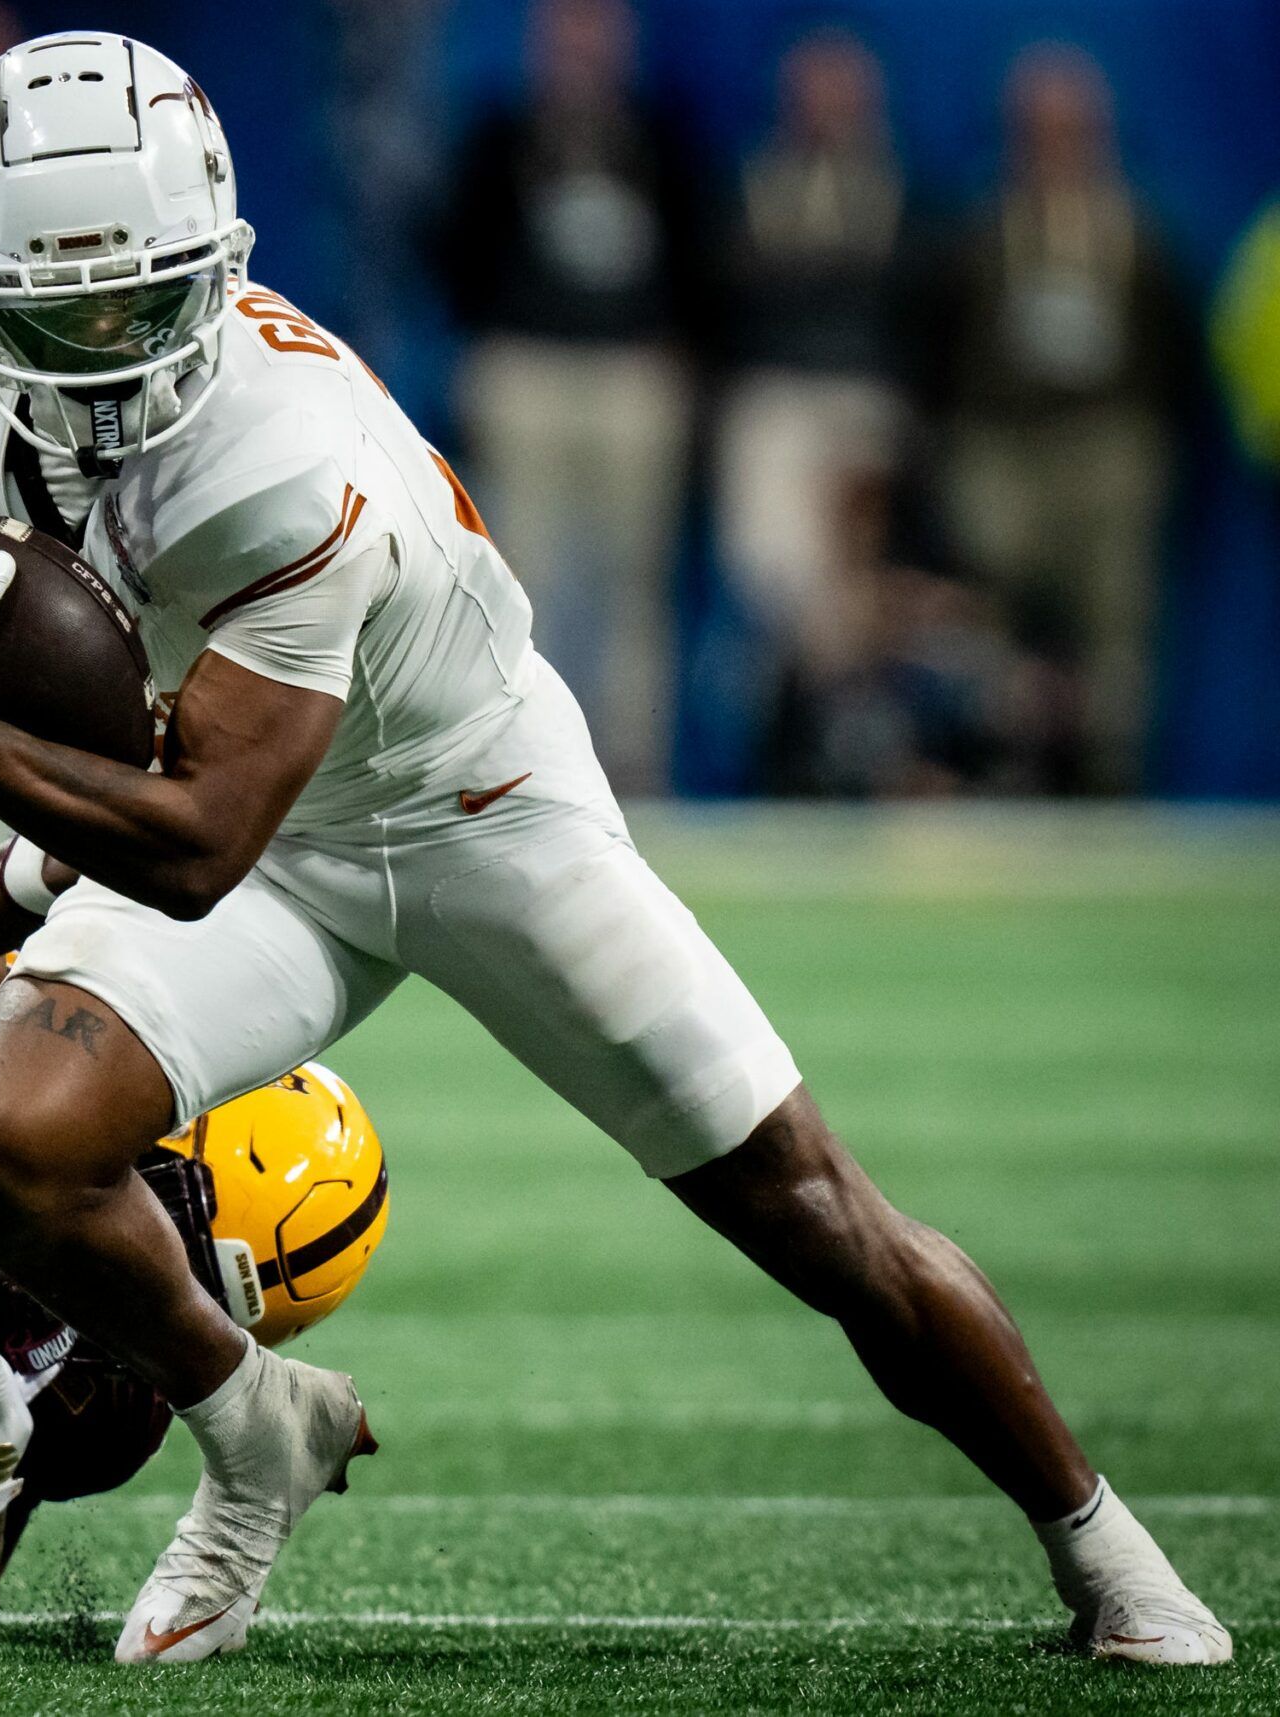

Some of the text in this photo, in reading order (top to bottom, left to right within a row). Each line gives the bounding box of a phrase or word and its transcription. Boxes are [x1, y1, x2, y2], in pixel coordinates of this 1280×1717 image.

[234, 290, 340, 361] GO
[18, 998, 106, 1057] AR
[235, 1253, 252, 1280] SUN
